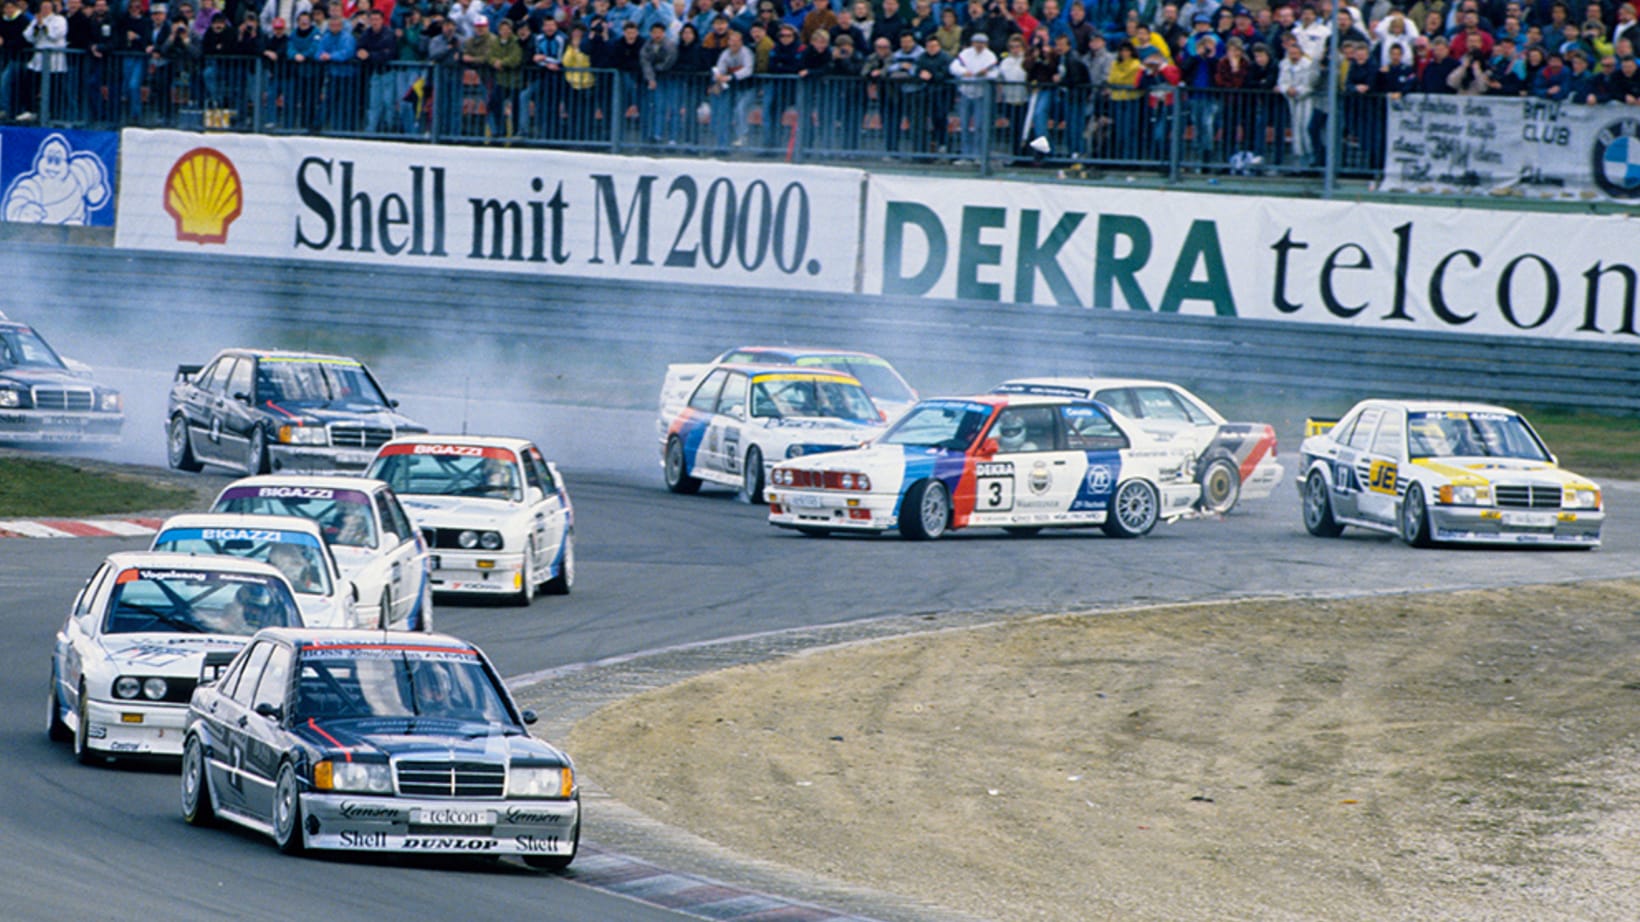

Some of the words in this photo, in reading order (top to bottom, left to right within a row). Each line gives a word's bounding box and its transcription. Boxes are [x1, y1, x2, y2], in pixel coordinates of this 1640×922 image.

[1523, 123, 1570, 146] CLUB
[294, 156, 448, 257] Shell
[467, 176, 571, 264] mit
[880, 200, 1239, 317] DEKRA
[1269, 221, 1640, 336] telcon
[413, 444, 483, 456] BIGAZZI
[258, 486, 335, 499] BIGAZZI
[988, 481, 1003, 507] 3
[201, 528, 282, 542] BIGAZZI
[340, 830, 387, 848] Shell
[402, 838, 499, 850] DUNLOP
[515, 834, 559, 852] Shell
